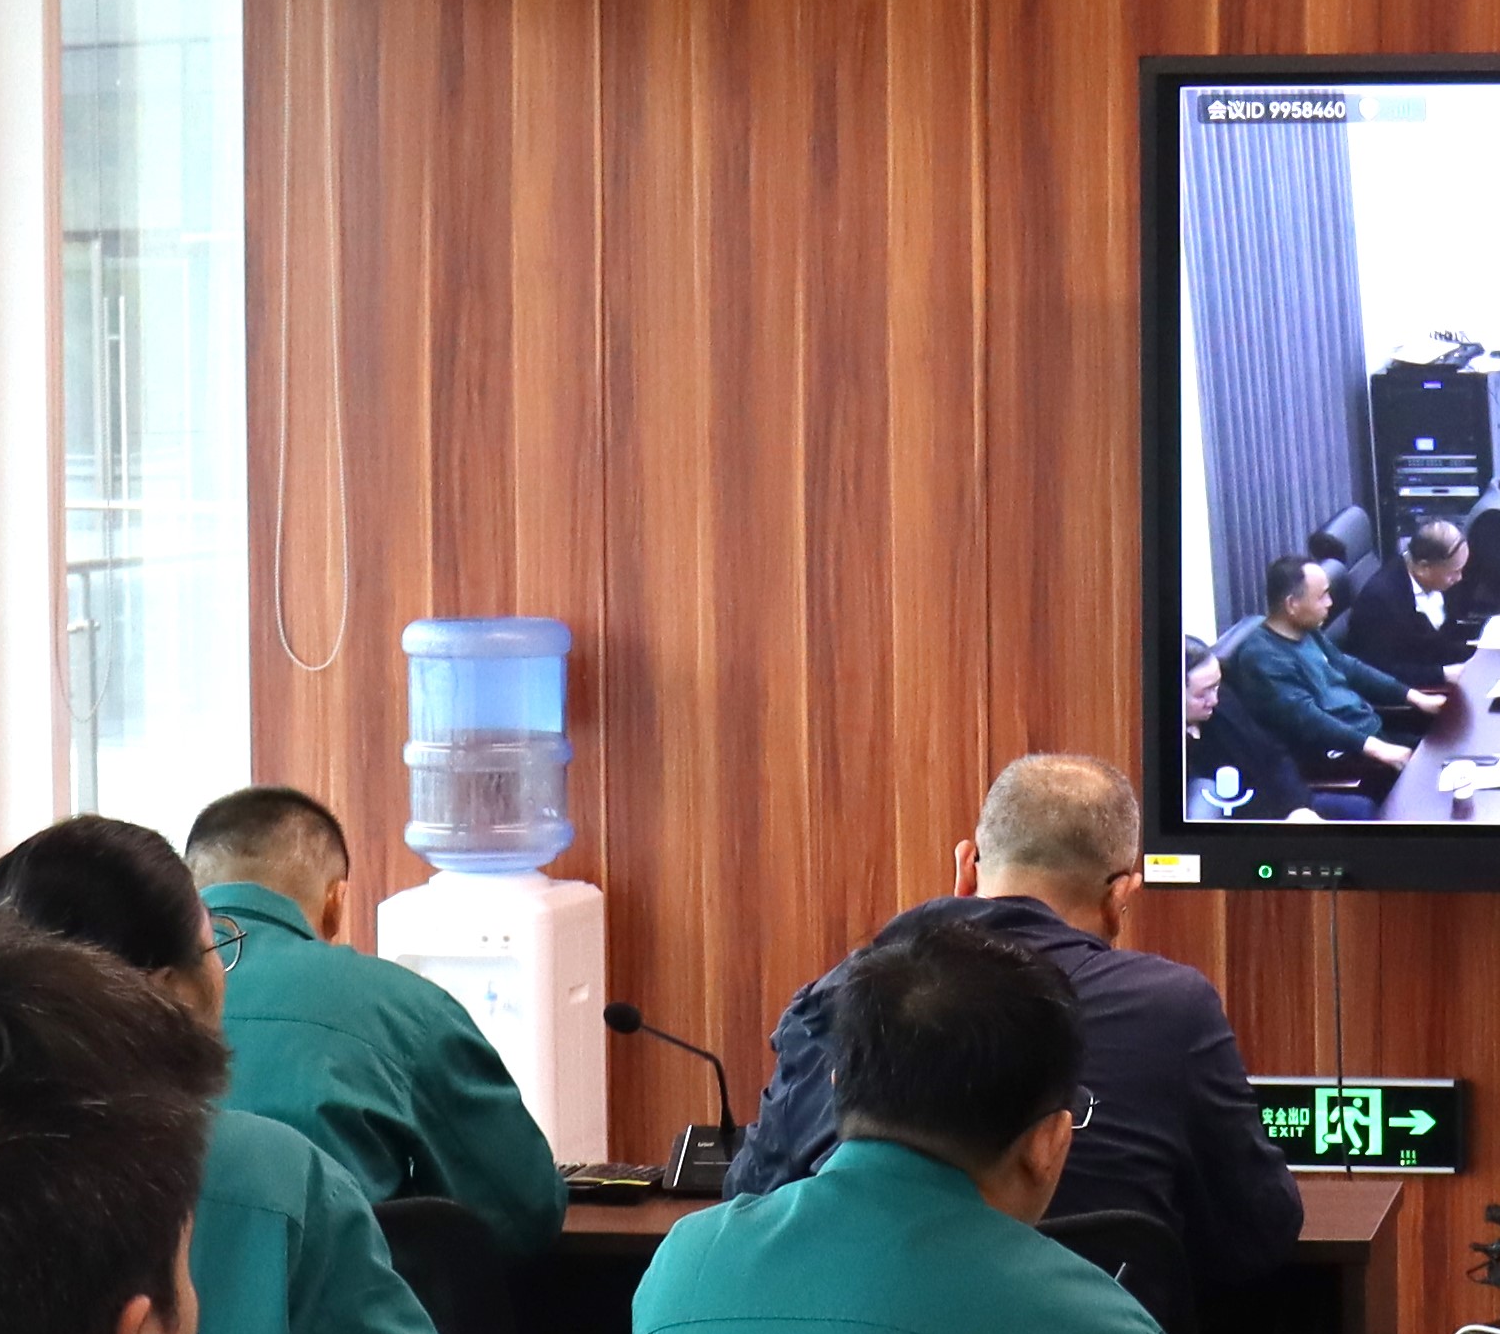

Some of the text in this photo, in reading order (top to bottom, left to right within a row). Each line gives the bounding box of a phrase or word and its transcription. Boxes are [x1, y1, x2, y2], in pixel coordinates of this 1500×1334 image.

[1207, 100, 1345, 120] 会议ID 9958460
[1262, 1107, 1310, 1126] 安全出口
[1268, 1126, 1305, 1138] EXIT
